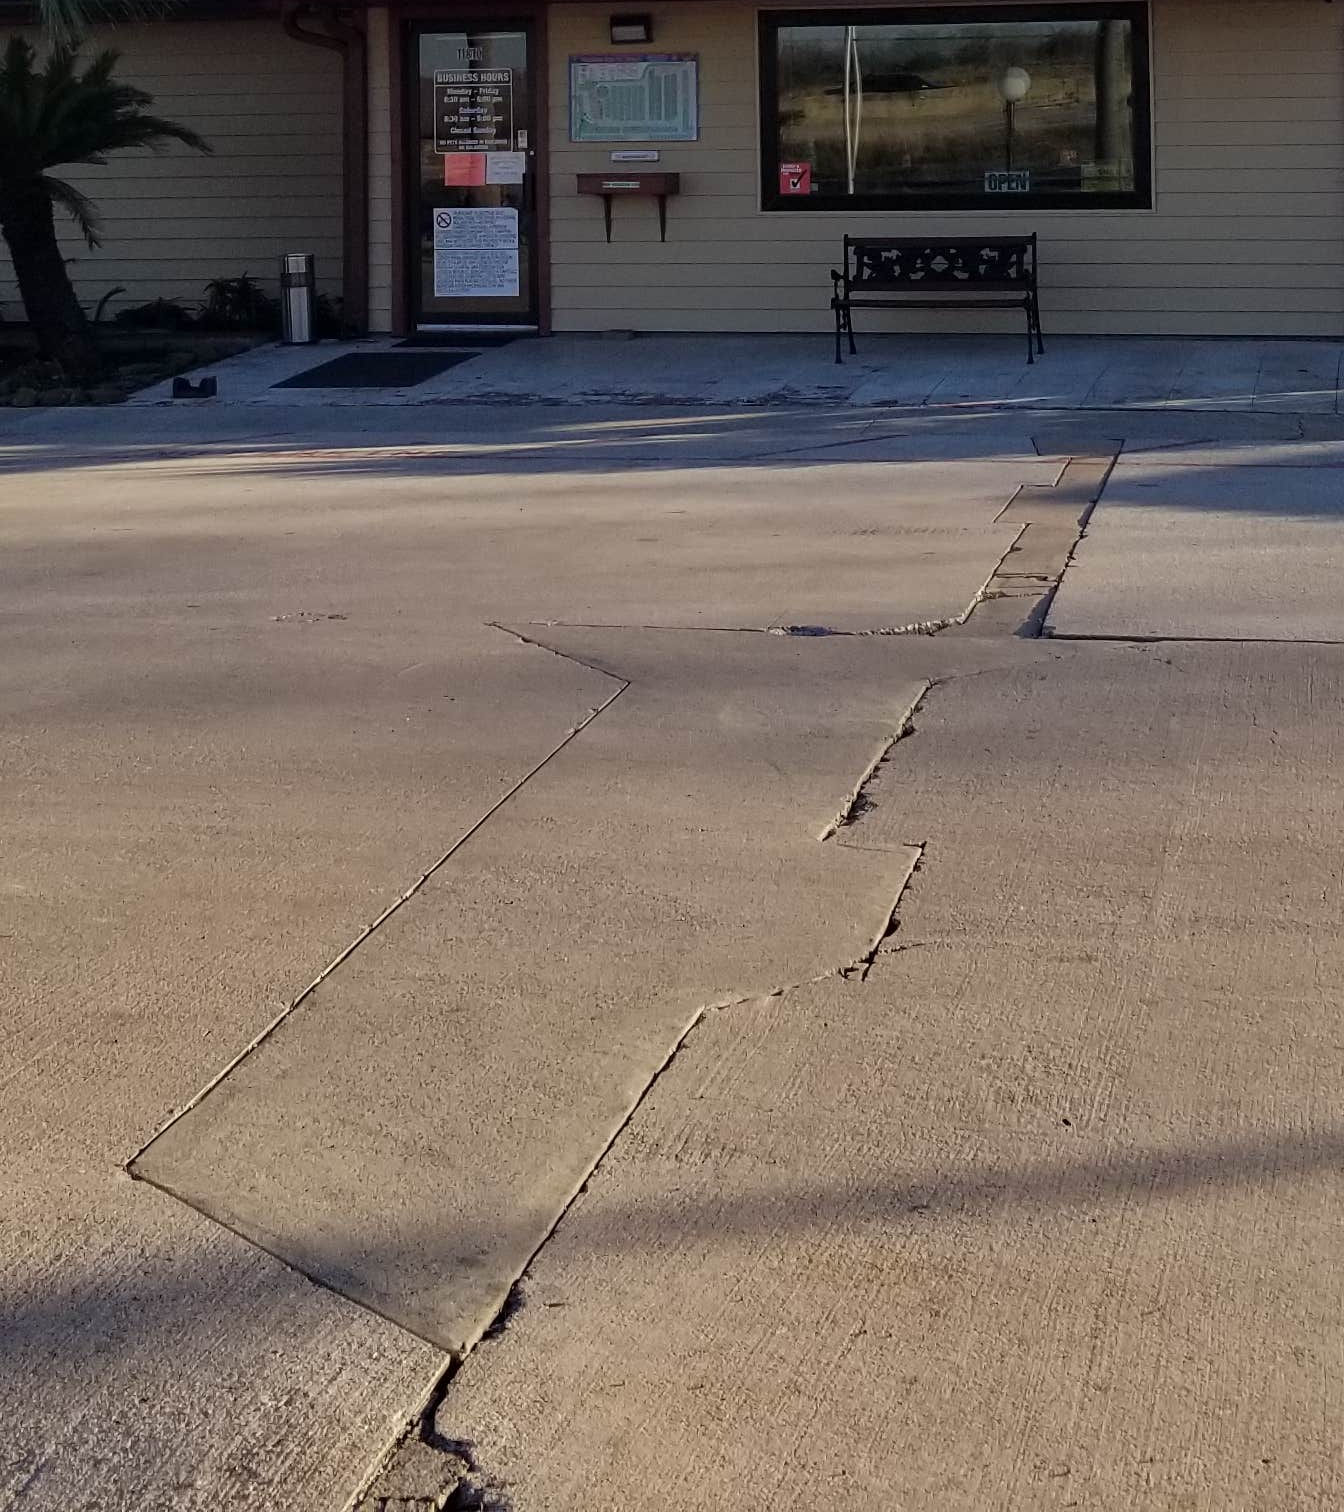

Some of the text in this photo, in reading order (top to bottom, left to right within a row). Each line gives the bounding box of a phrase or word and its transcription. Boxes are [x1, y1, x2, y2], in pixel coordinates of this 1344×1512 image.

[437, 72, 510, 83] BUSINESS HOURS
[987, 173, 1028, 192] OPEN
